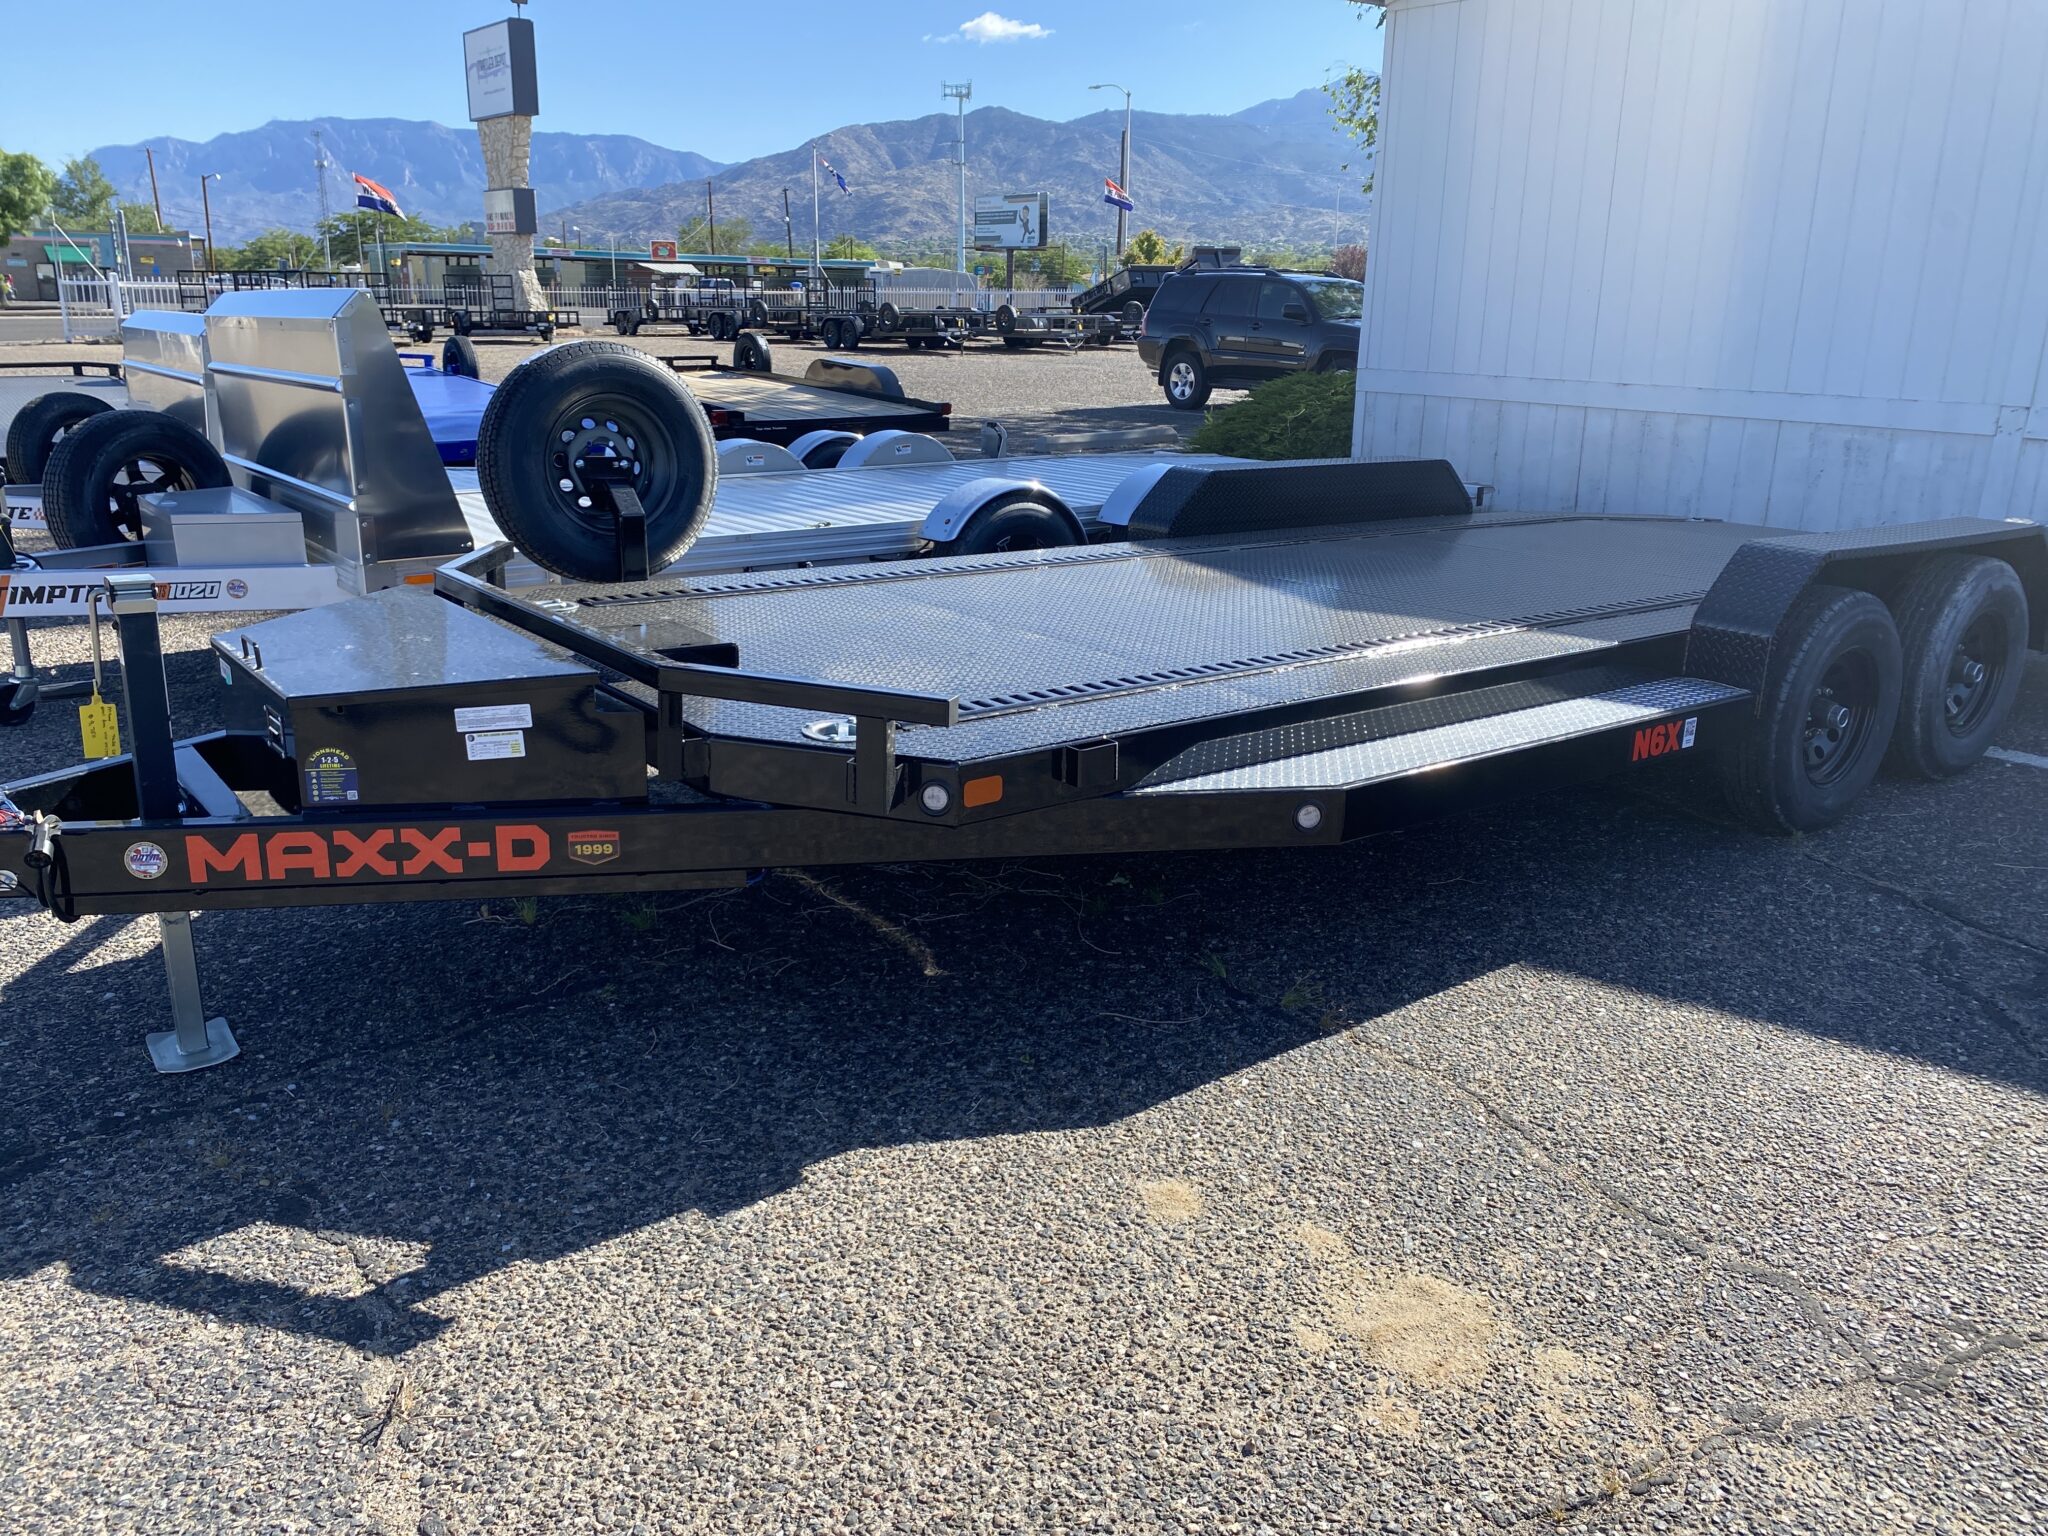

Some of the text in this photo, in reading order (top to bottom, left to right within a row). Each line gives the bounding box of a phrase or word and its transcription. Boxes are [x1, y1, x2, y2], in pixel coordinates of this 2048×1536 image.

[168, 581, 221, 599] 1020
[1632, 720, 1683, 761] N6X
[185, 825, 550, 883] MAXX-D
[574, 843, 613, 856] 1999
